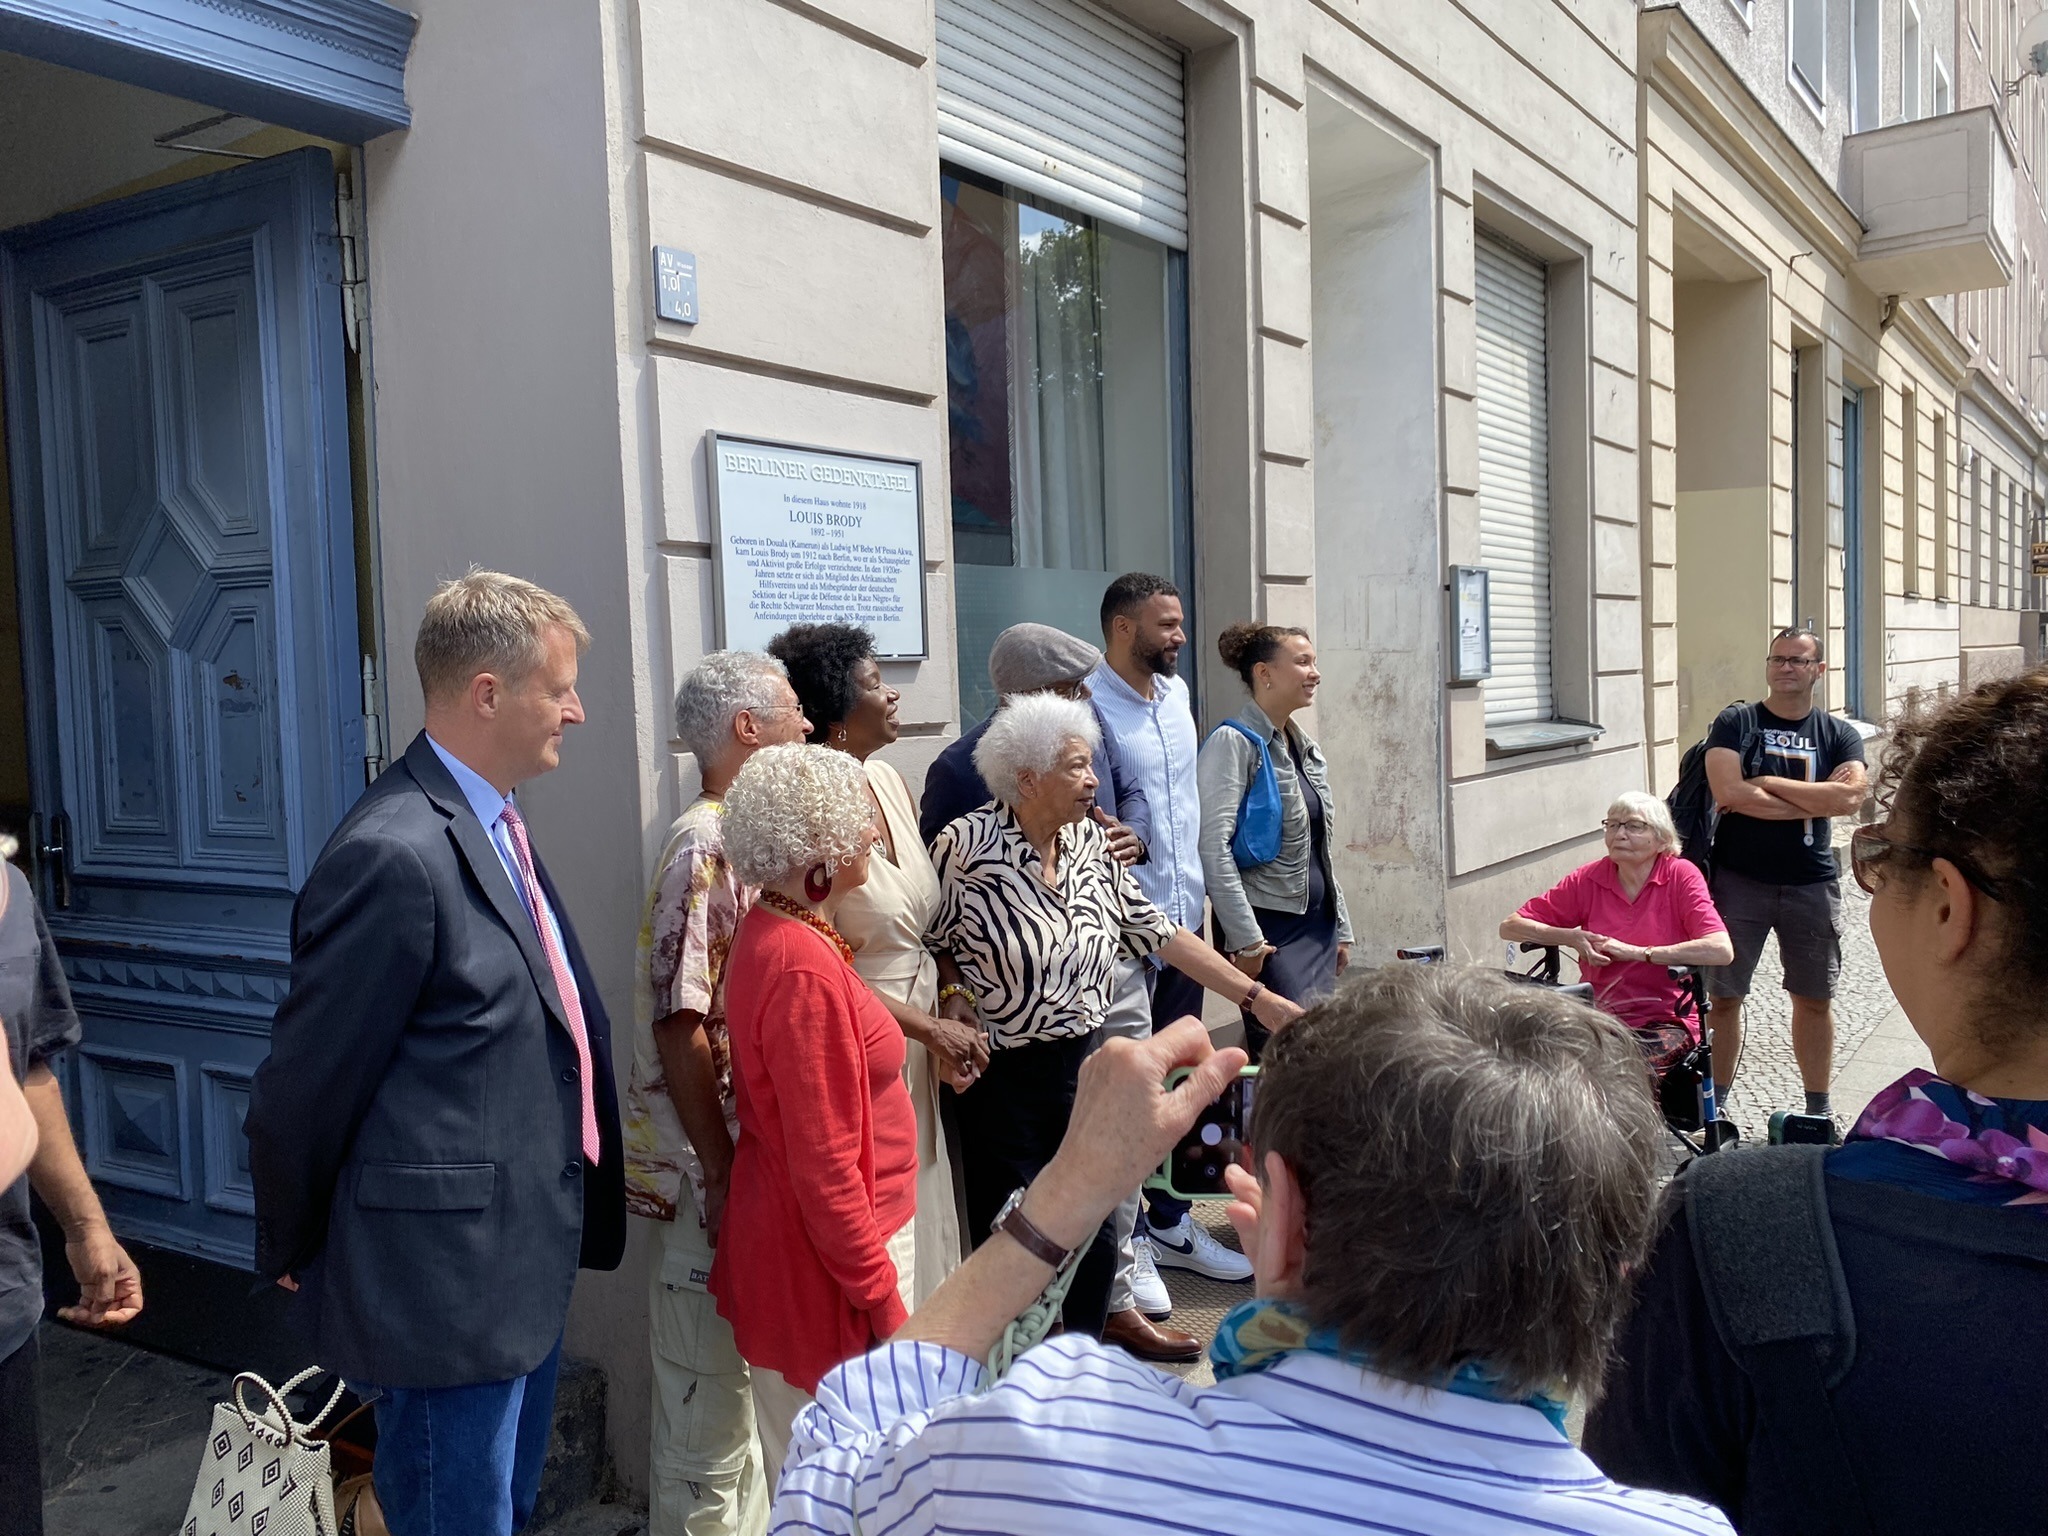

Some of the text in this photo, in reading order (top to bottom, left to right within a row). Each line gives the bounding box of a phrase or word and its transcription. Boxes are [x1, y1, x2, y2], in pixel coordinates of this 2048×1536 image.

[661, 252, 673, 267] AV
[675, 301, 691, 317] 4,0
[725, 453, 912, 492] BERLINER GEDENKTAFEL
[784, 494, 866, 510] In diesem Haus wohnte 1918
[790, 510, 862, 528] LOUIS BRODY
[730, 536, 757, 545] Geboren
[766, 539, 788, 547] Douala
[789, 540, 820, 550] (Kamerun)
[830, 543, 851, 554] Ludwig
[898, 548, 913, 556] Akwa,
[736, 547, 749, 555] kam
[751, 548, 769, 556] Louis
[771, 549, 789, 560] Brody
[803, 551, 817, 559] 1912
[833, 554, 852, 562] Berlin,
[878, 557, 910, 566] Schauspieler
[761, 560, 785, 568] Aktivist
[787, 561, 803, 570] große
[805, 561, 826, 571] Erfolge
[883, 565, 902, 574] 1920er-
[755, 569, 775, 578] Jahren
[825, 573, 849, 582] Mitglied
[861, 575, 897, 583] Afrikanischen
[759, 580, 796, 589] Hilfsvereins
[810, 582, 818, 590] als
[820, 583, 857, 592] Mitbegründer
[752, 590, 776, 599] Sektion
[777, 591, 787, 599] der
[820, 593, 842, 601] Défense
[852, 593, 857, 601] la
[858, 594, 871, 602] Race
[761, 601, 782, 609] Rechte
[783, 602, 814, 610] Schwarzer
[815, 603, 844, 611] Menschen
[754, 612, 797, 621] Anfeindungen
[799, 612, 825, 621] überlebte
[844, 613, 876, 624] NS-Regime
[1764, 733, 1817, 750] SOUL
